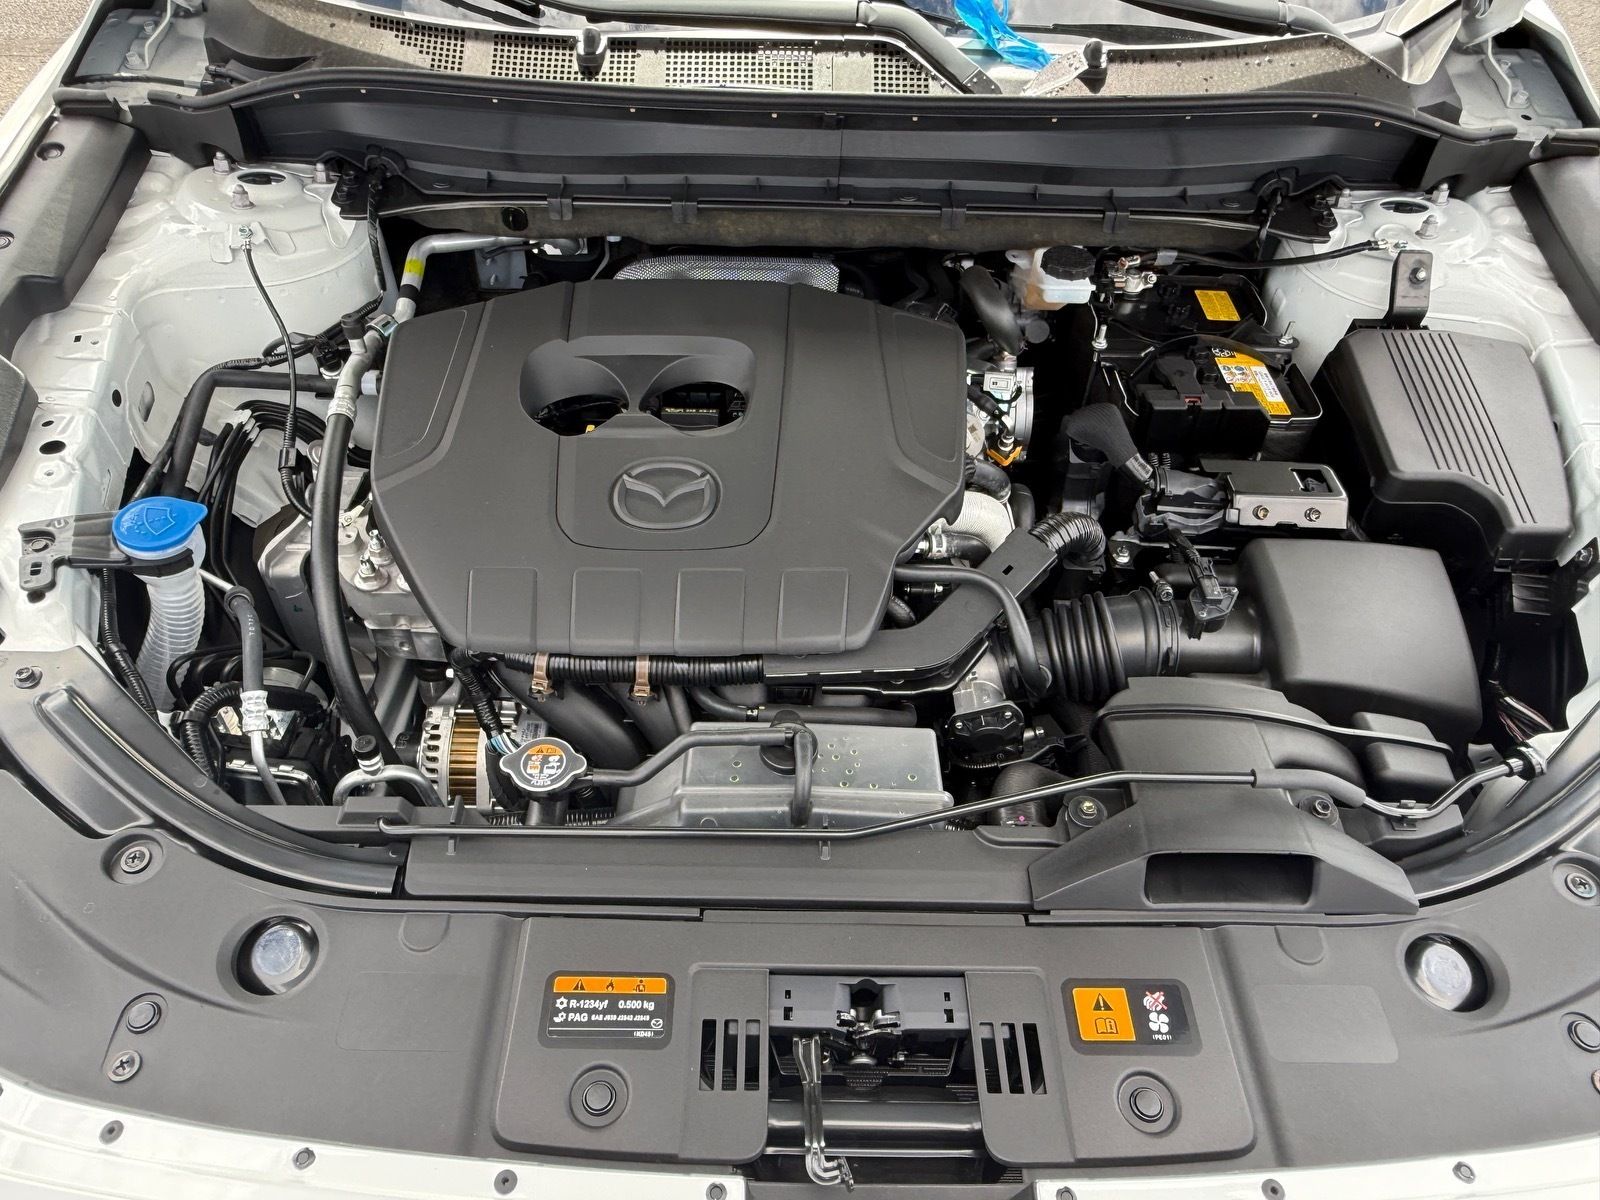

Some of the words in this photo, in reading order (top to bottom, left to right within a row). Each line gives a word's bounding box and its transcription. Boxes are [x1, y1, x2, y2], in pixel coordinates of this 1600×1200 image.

[569, 1000, 608, 1010] R-1234yf
[618, 1000, 642, 1009] 0.500
[643, 1000, 655, 1011] kg
[568, 1013, 588, 1022] PAG
